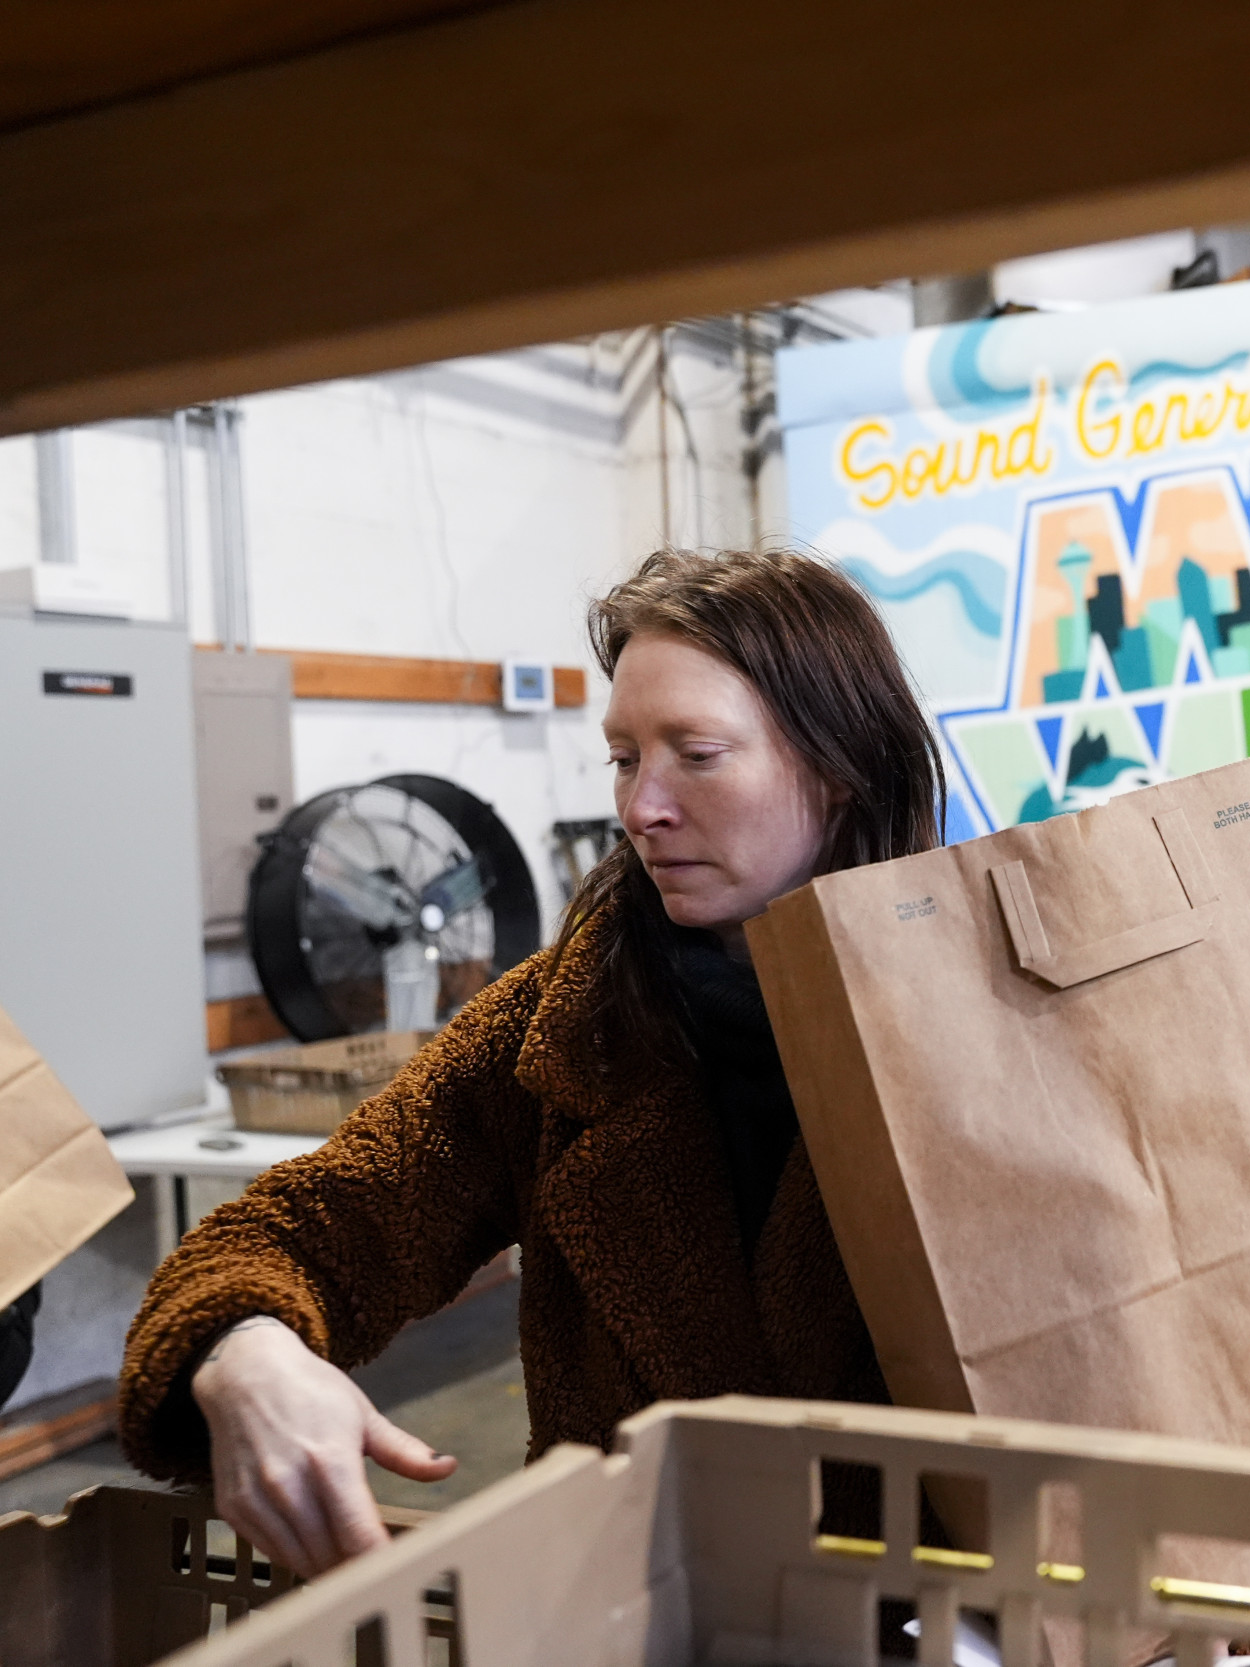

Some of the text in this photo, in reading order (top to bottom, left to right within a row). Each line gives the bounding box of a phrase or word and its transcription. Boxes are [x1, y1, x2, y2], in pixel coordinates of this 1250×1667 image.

[840, 374, 1053, 511] Sound
[1216, 802, 1250, 818] PLEASE
[1213, 816, 1238, 829] BOTH
[895, 896, 934, 912] PULL UP
[898, 905, 937, 921] NOT OUT
